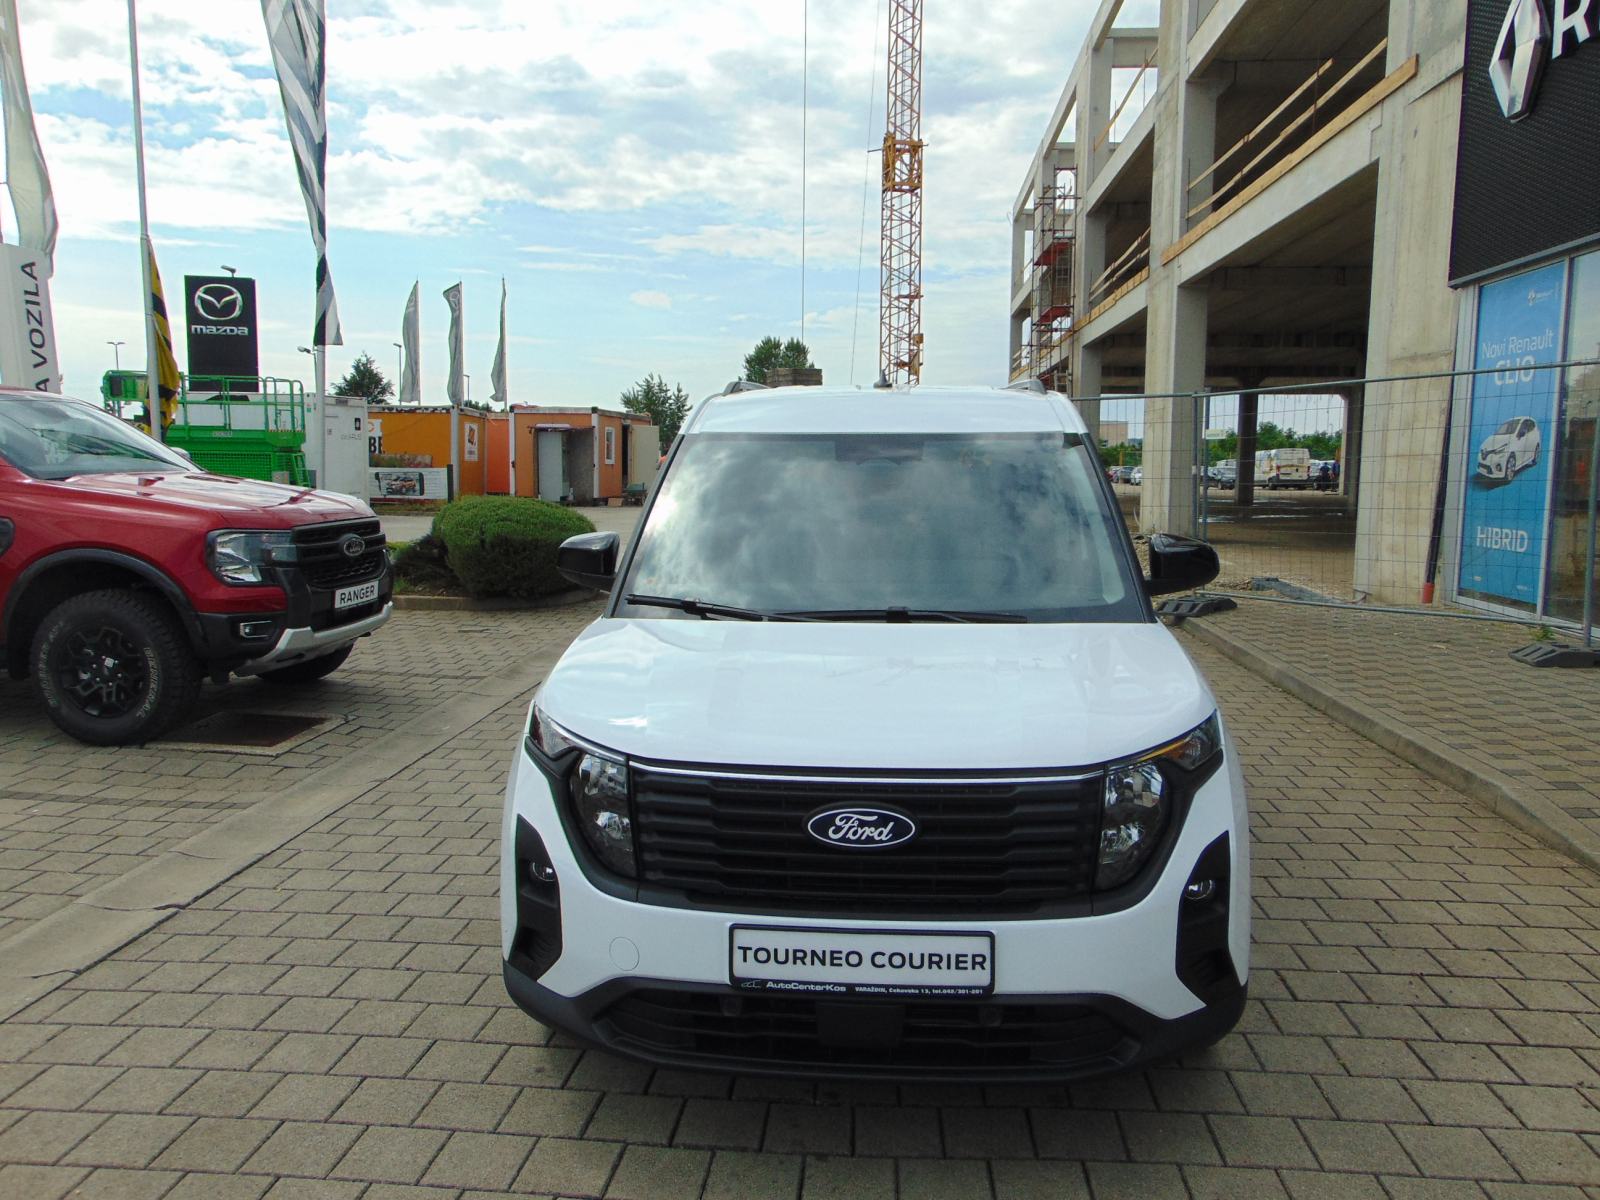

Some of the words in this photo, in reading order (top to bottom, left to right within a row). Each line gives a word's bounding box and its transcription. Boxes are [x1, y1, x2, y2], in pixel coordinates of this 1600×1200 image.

[21, 262, 48, 369] VOZILA
[191, 325, 249, 336] mazda
[1482, 338, 1506, 359] Novi
[1508, 328, 1554, 355] Renault
[1495, 355, 1536, 386] CLIO
[1476, 526, 1528, 553] HIBRID
[339, 584, 375, 605] RANGER
[828, 813, 895, 841] Ford
[737, 945, 863, 968] TOURNEO
[870, 951, 988, 971] COURIER
[766, 981, 847, 992] AutoCenterKos
